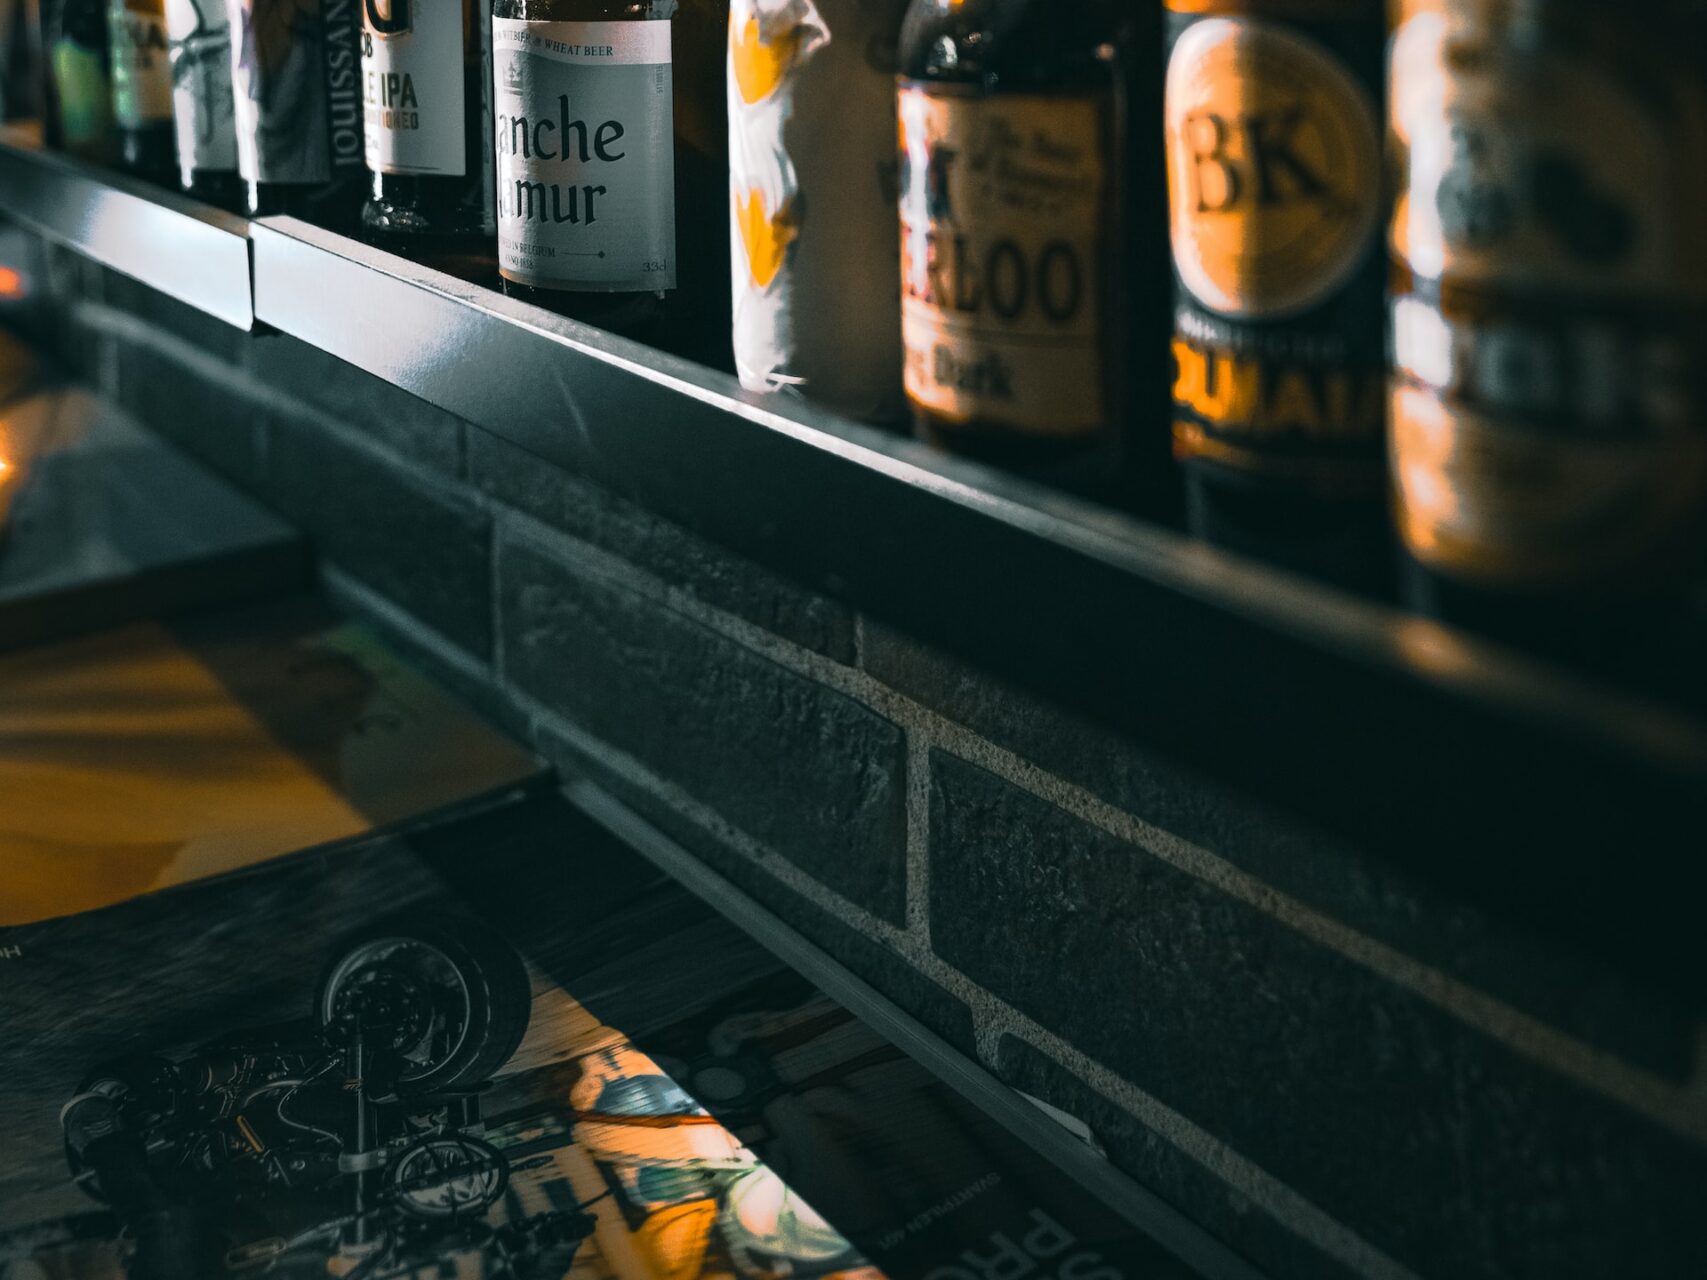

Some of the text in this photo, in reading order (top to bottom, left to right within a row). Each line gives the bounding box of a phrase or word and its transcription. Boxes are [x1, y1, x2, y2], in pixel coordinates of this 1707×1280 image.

[545, 39, 581, 56] WHEAT
[584, 46, 614, 57] BEER
[381, 72, 419, 108] IPA
[1187, 110, 1334, 210] BK
[519, 242, 556, 258] BELGIUM
